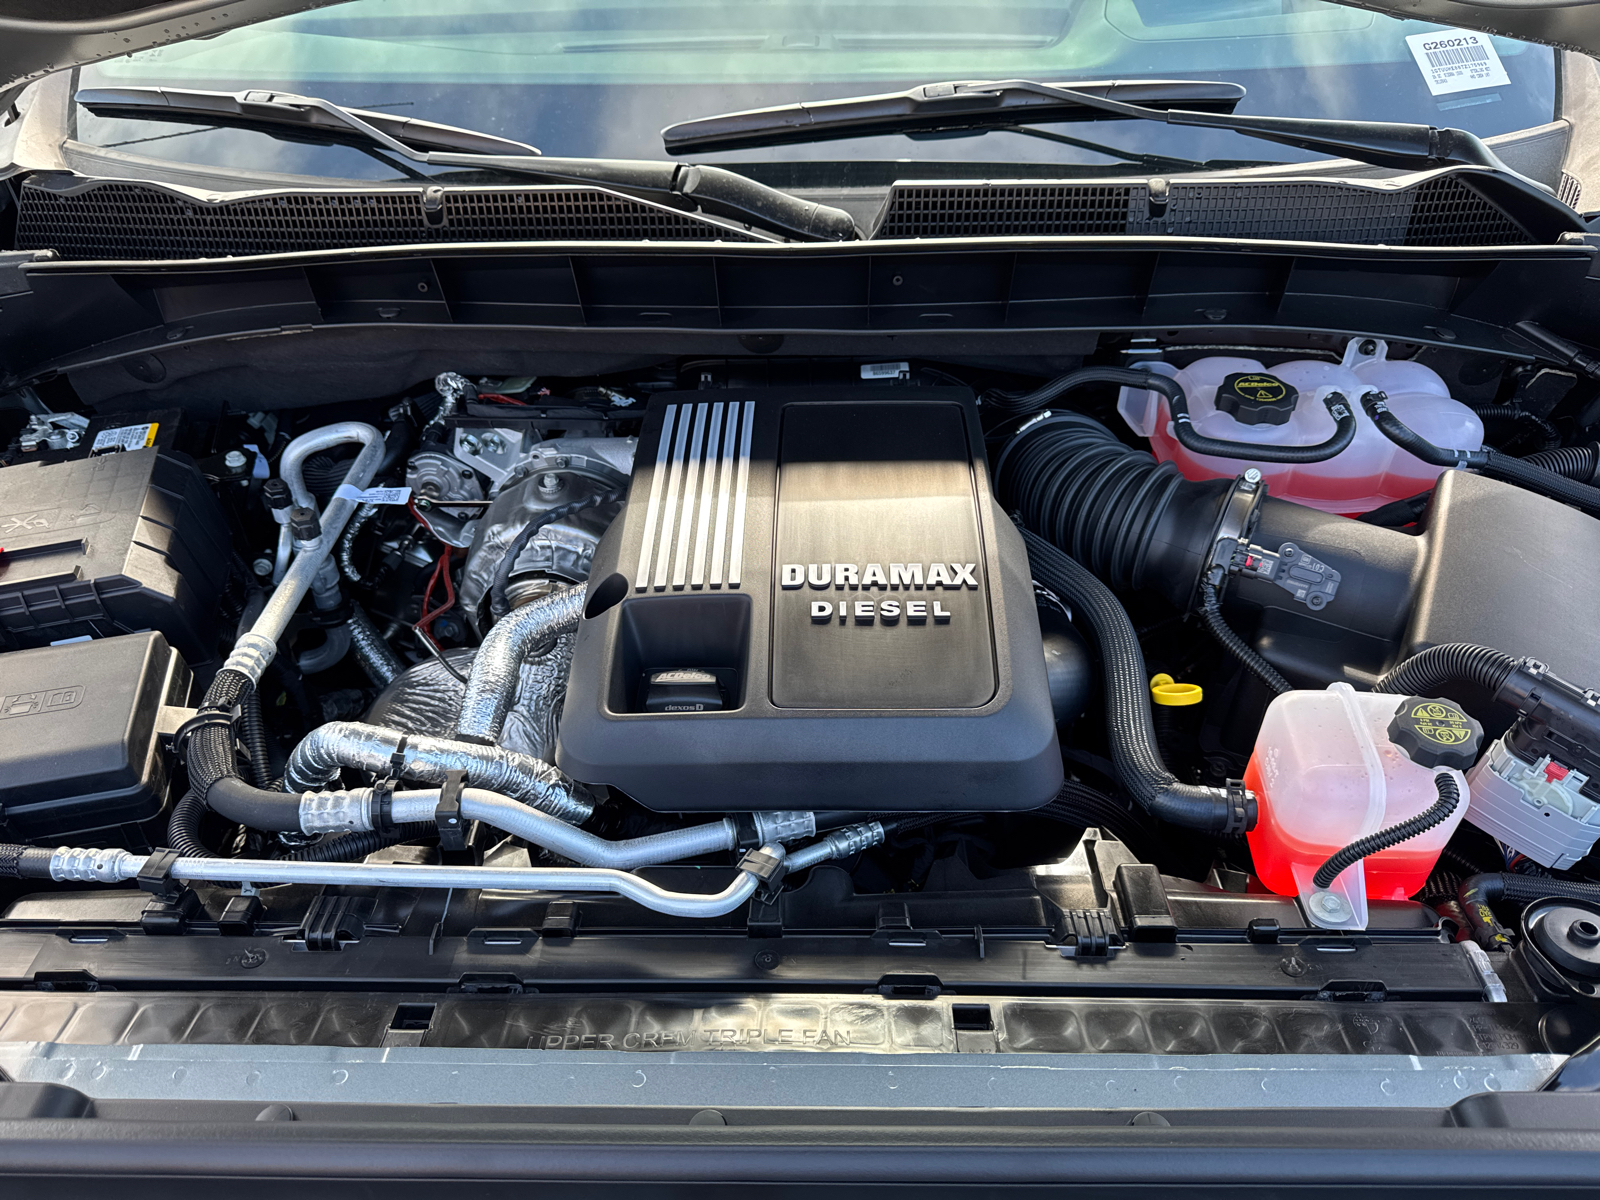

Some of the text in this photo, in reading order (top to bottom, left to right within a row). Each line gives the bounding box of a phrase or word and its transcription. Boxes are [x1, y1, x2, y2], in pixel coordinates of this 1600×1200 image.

[1423, 36, 1478, 51] G260213
[781, 563, 978, 589] DURAMAX
[811, 601, 951, 622] DIESEL
[657, 672, 711, 681] ACDelco
[526, 1033, 614, 1050] UPPER
[704, 1028, 795, 1046] TRIPLE
[802, 1028, 852, 1047] FAN
